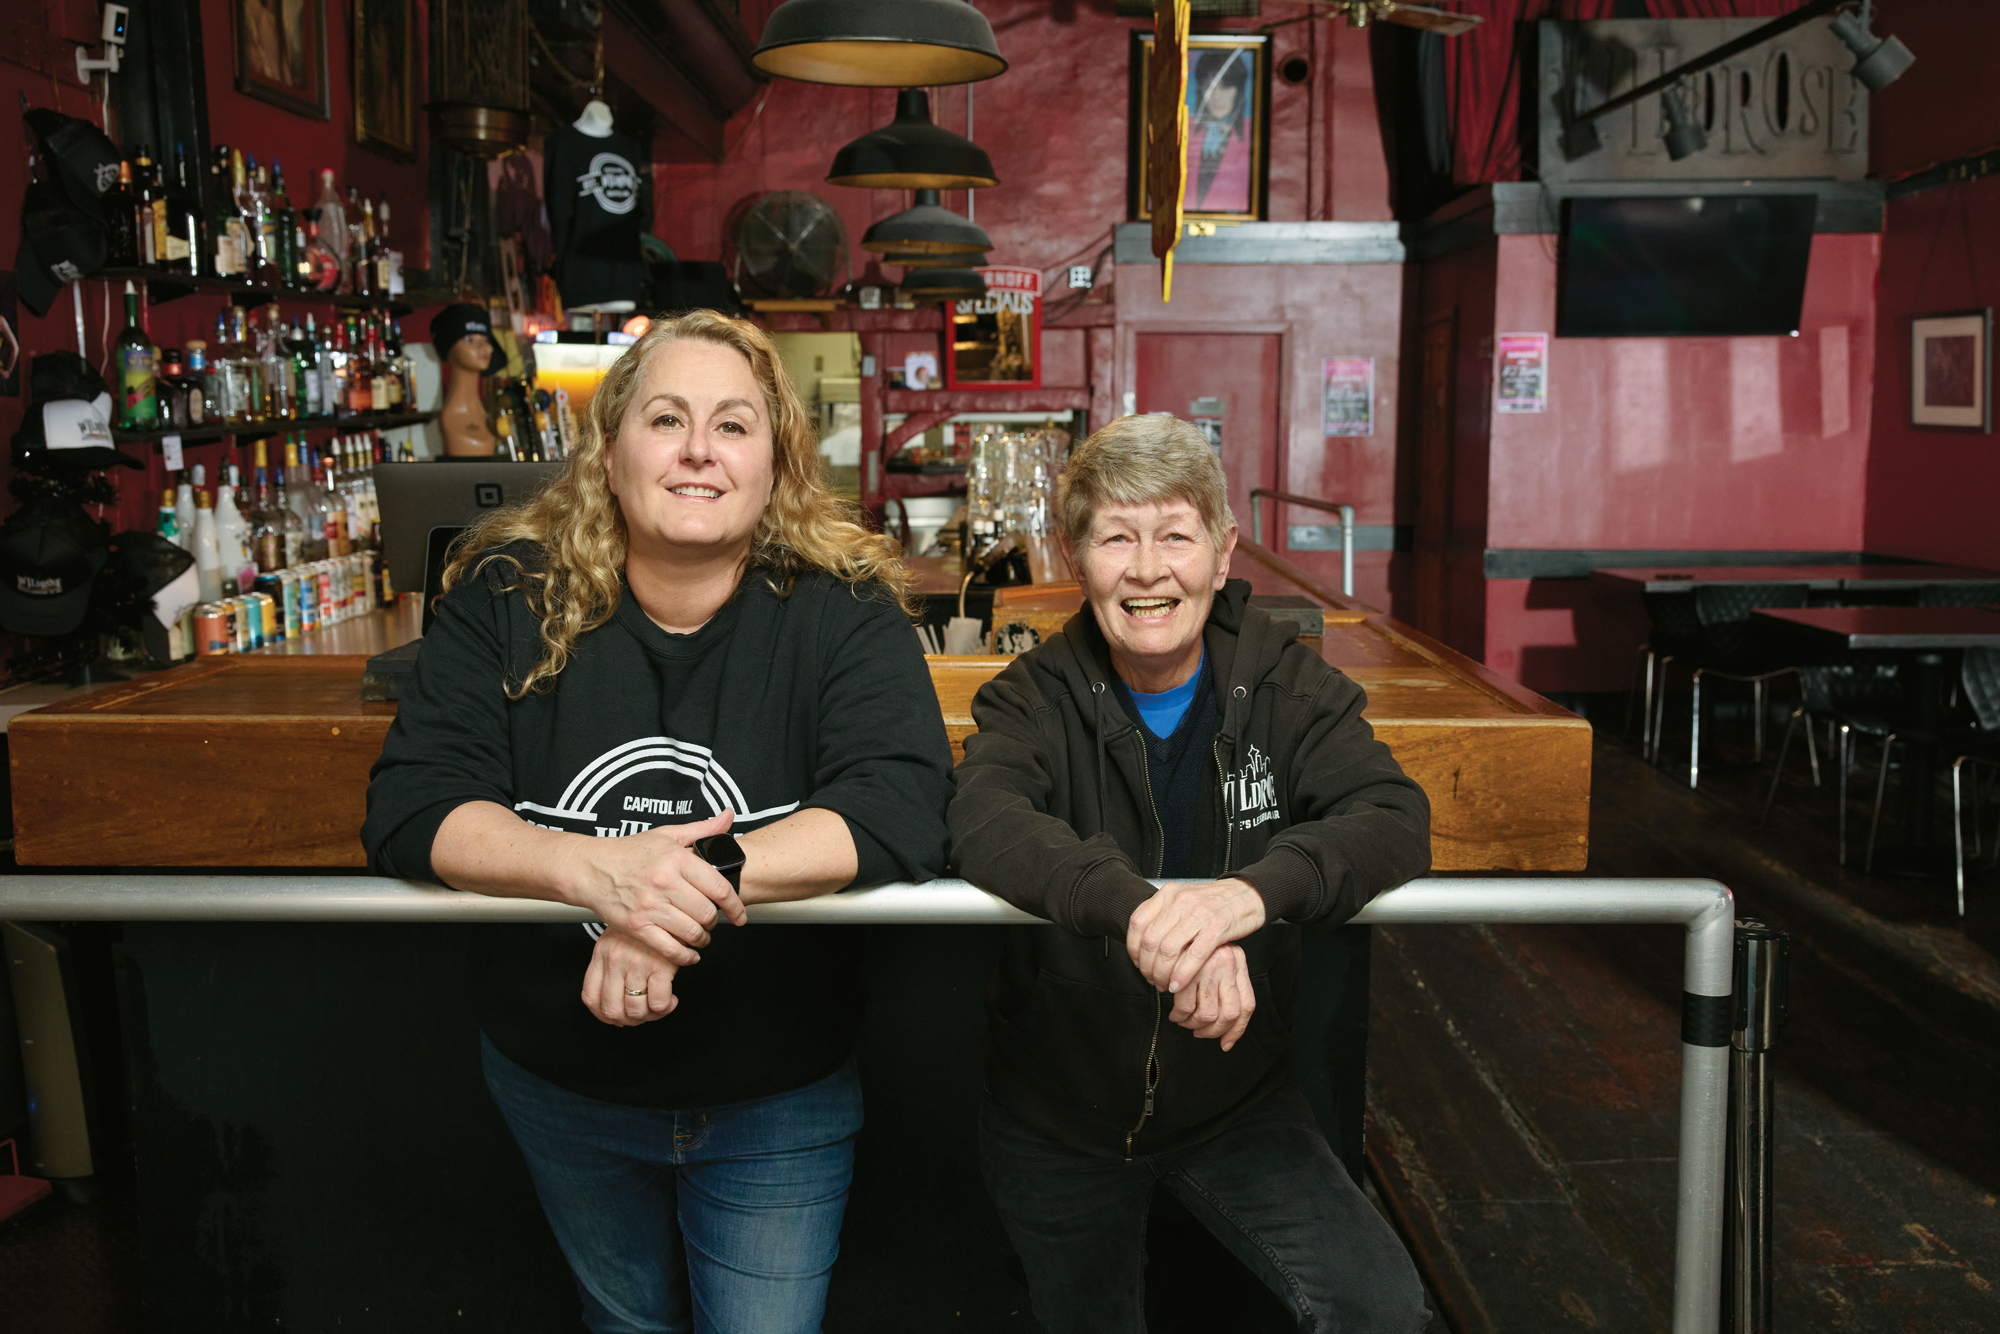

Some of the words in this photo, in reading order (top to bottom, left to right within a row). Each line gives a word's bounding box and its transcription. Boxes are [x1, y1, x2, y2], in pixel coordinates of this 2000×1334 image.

[985, 271, 1033, 288] RNOFF
[623, 796, 675, 815] CAPITOL
[675, 799, 693, 815] HILL
